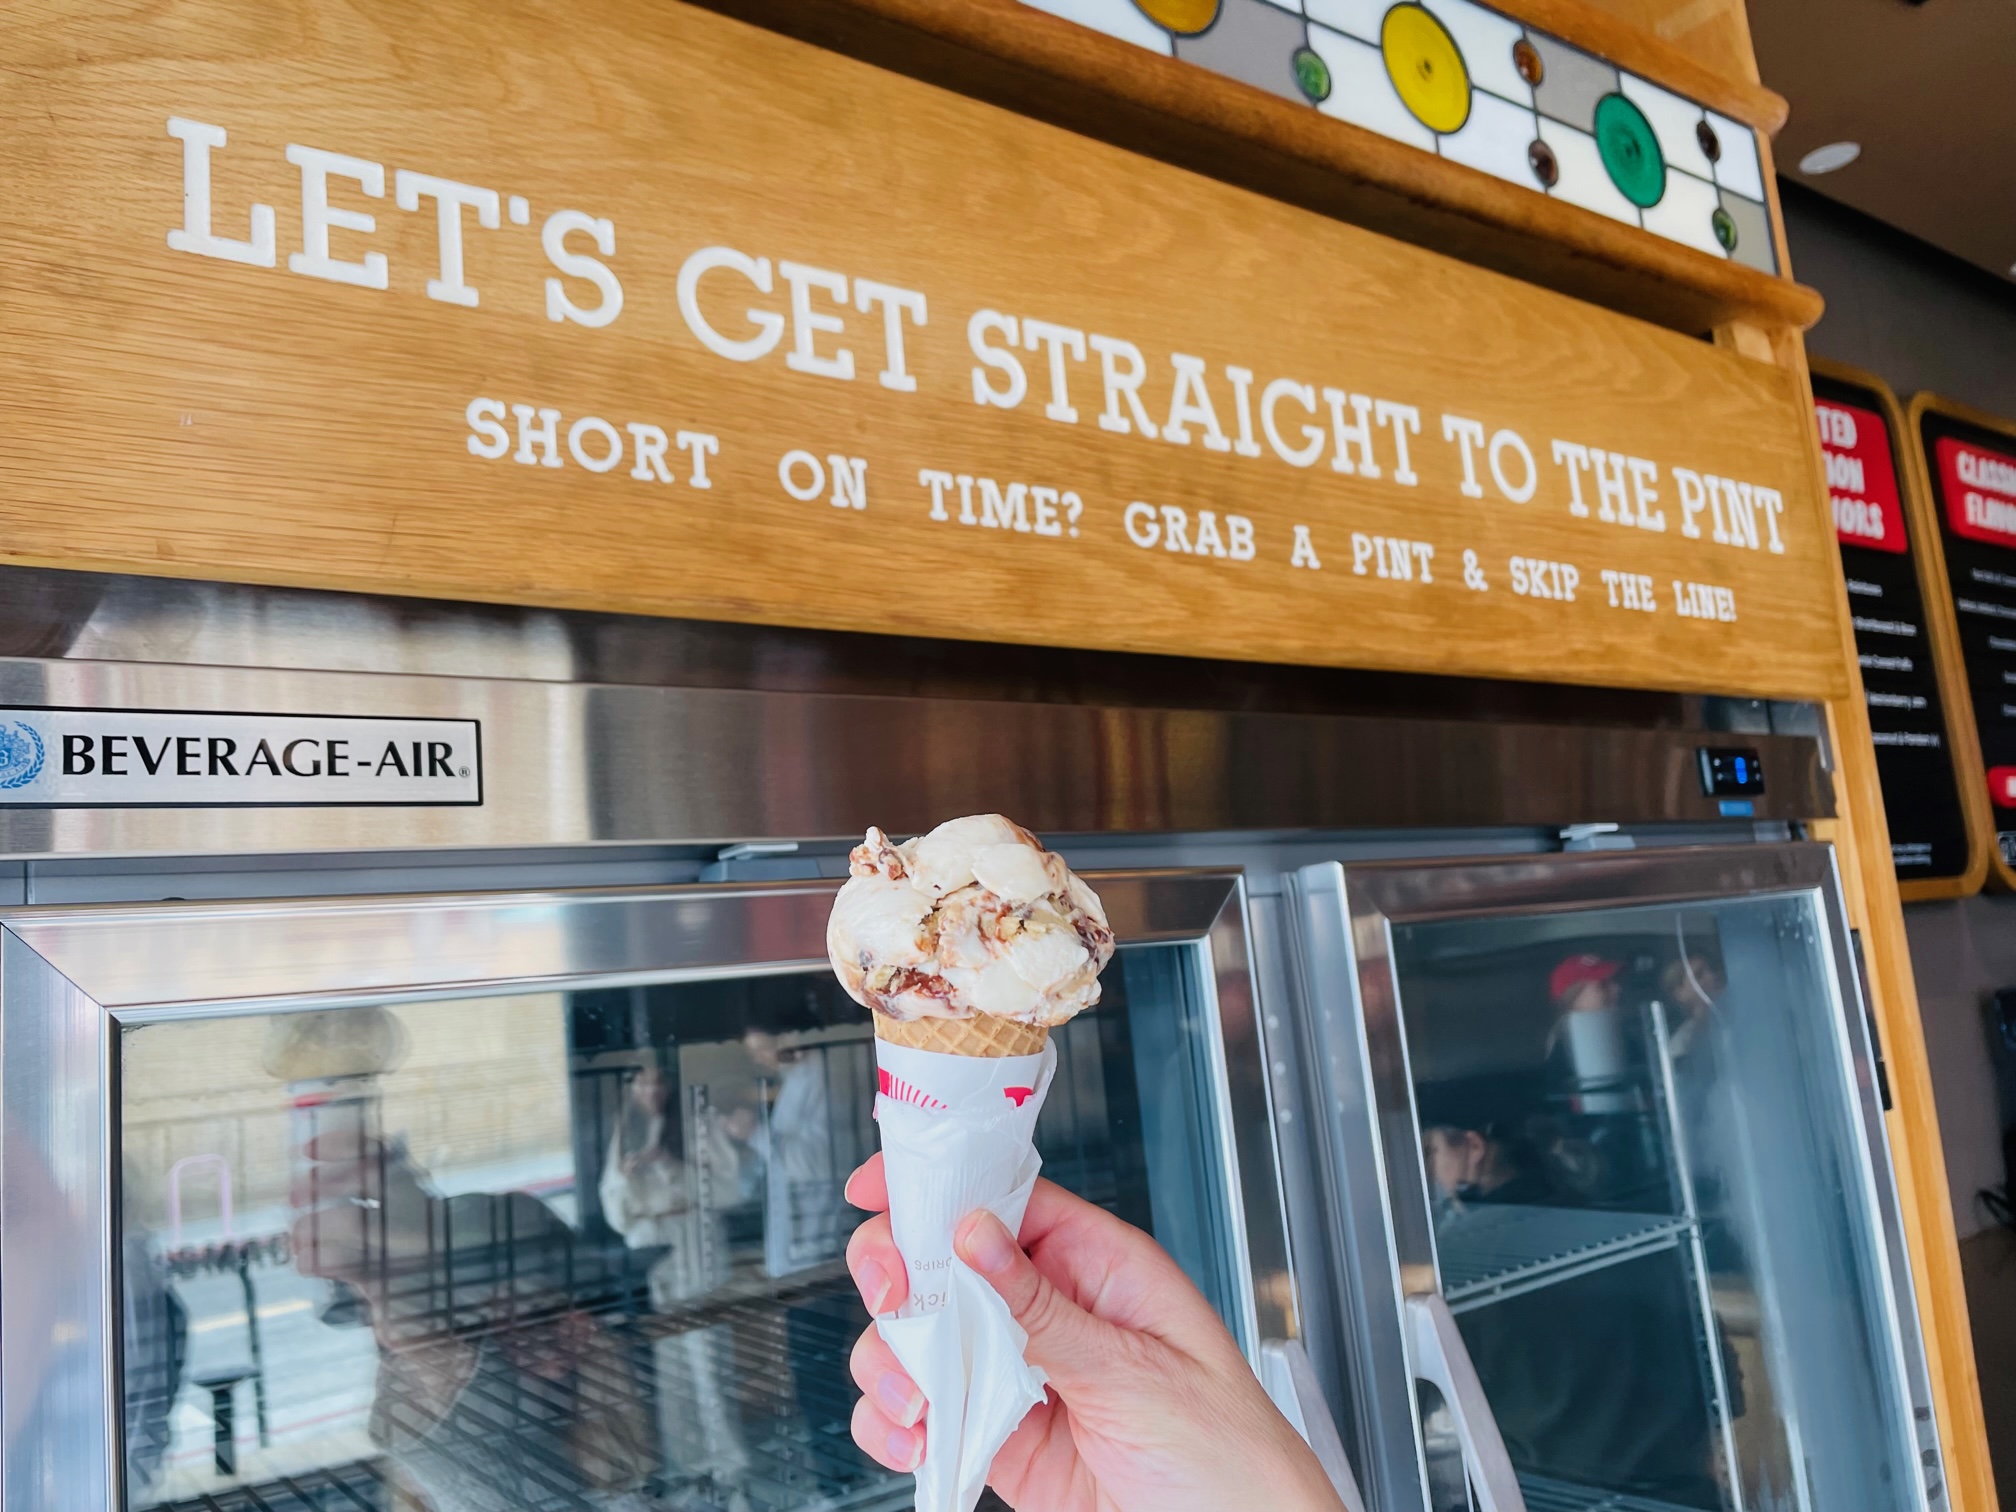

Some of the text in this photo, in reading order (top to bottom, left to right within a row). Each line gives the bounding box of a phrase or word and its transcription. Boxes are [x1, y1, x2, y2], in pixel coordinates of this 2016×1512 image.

[166, 113, 1785, 554] LET'S GET STRAIGHT TO THE PINT
[465, 397, 1736, 621] SHORT ON TIME? GRAB A PINT & SKIP THE LINE!
